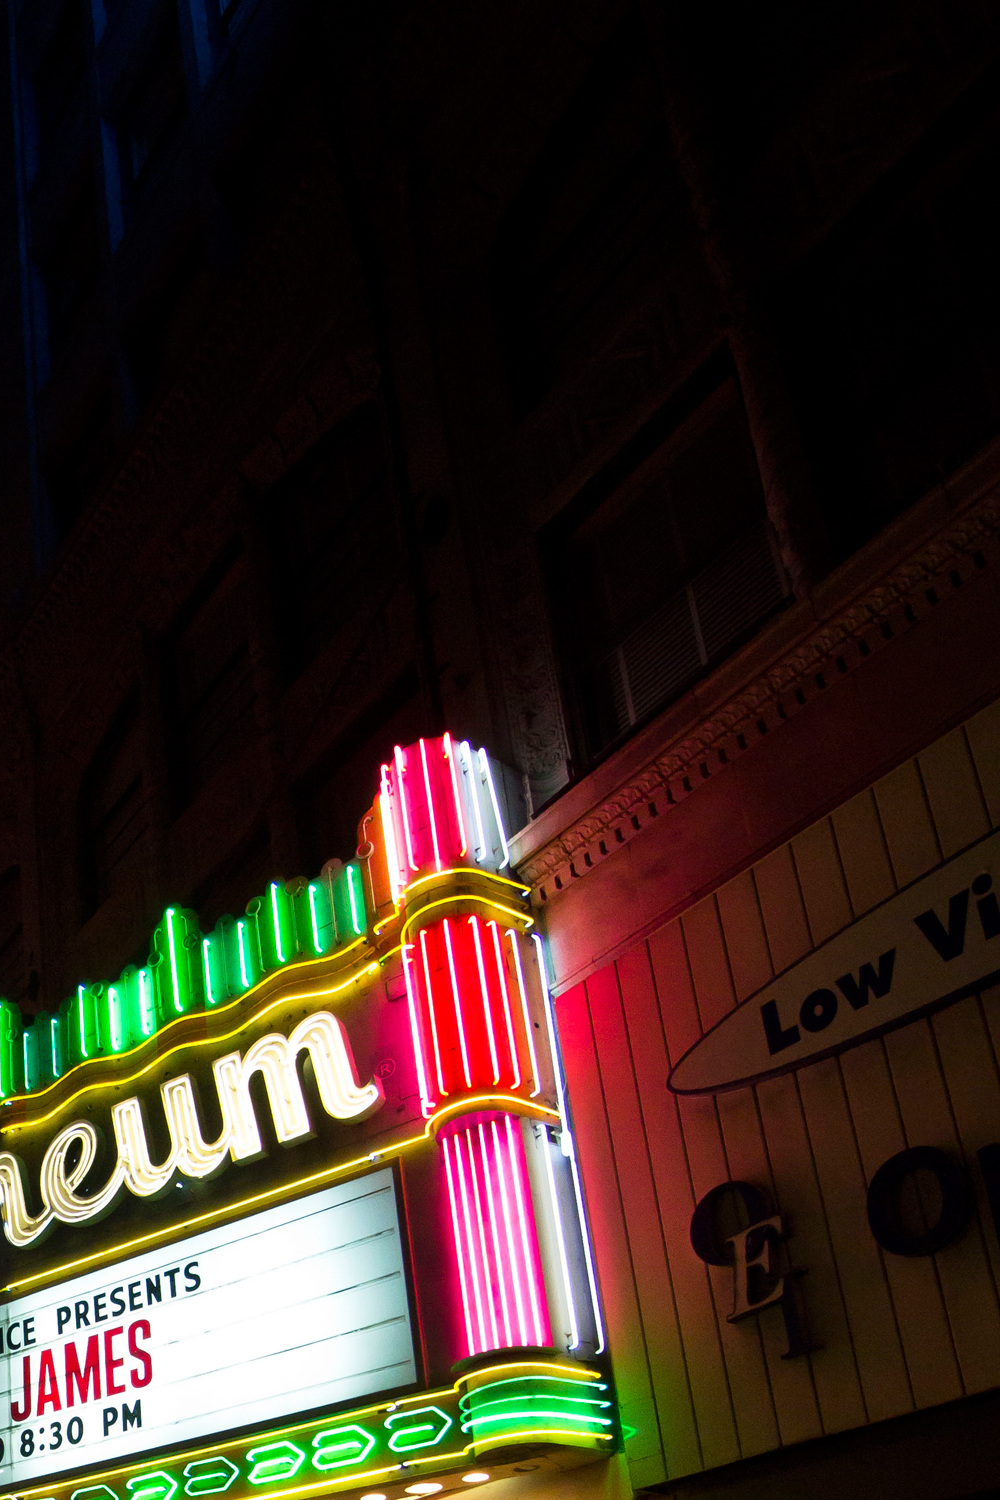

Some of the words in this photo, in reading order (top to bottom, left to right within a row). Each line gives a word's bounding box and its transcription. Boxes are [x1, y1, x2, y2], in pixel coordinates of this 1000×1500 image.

[760, 948, 896, 1056] Low
[56, 1261, 201, 1334] PRESENTS
[10, 1319, 153, 1422] JAMES
[20, 1416, 84, 1457] 8:30
[102, 1399, 142, 1436] PM
